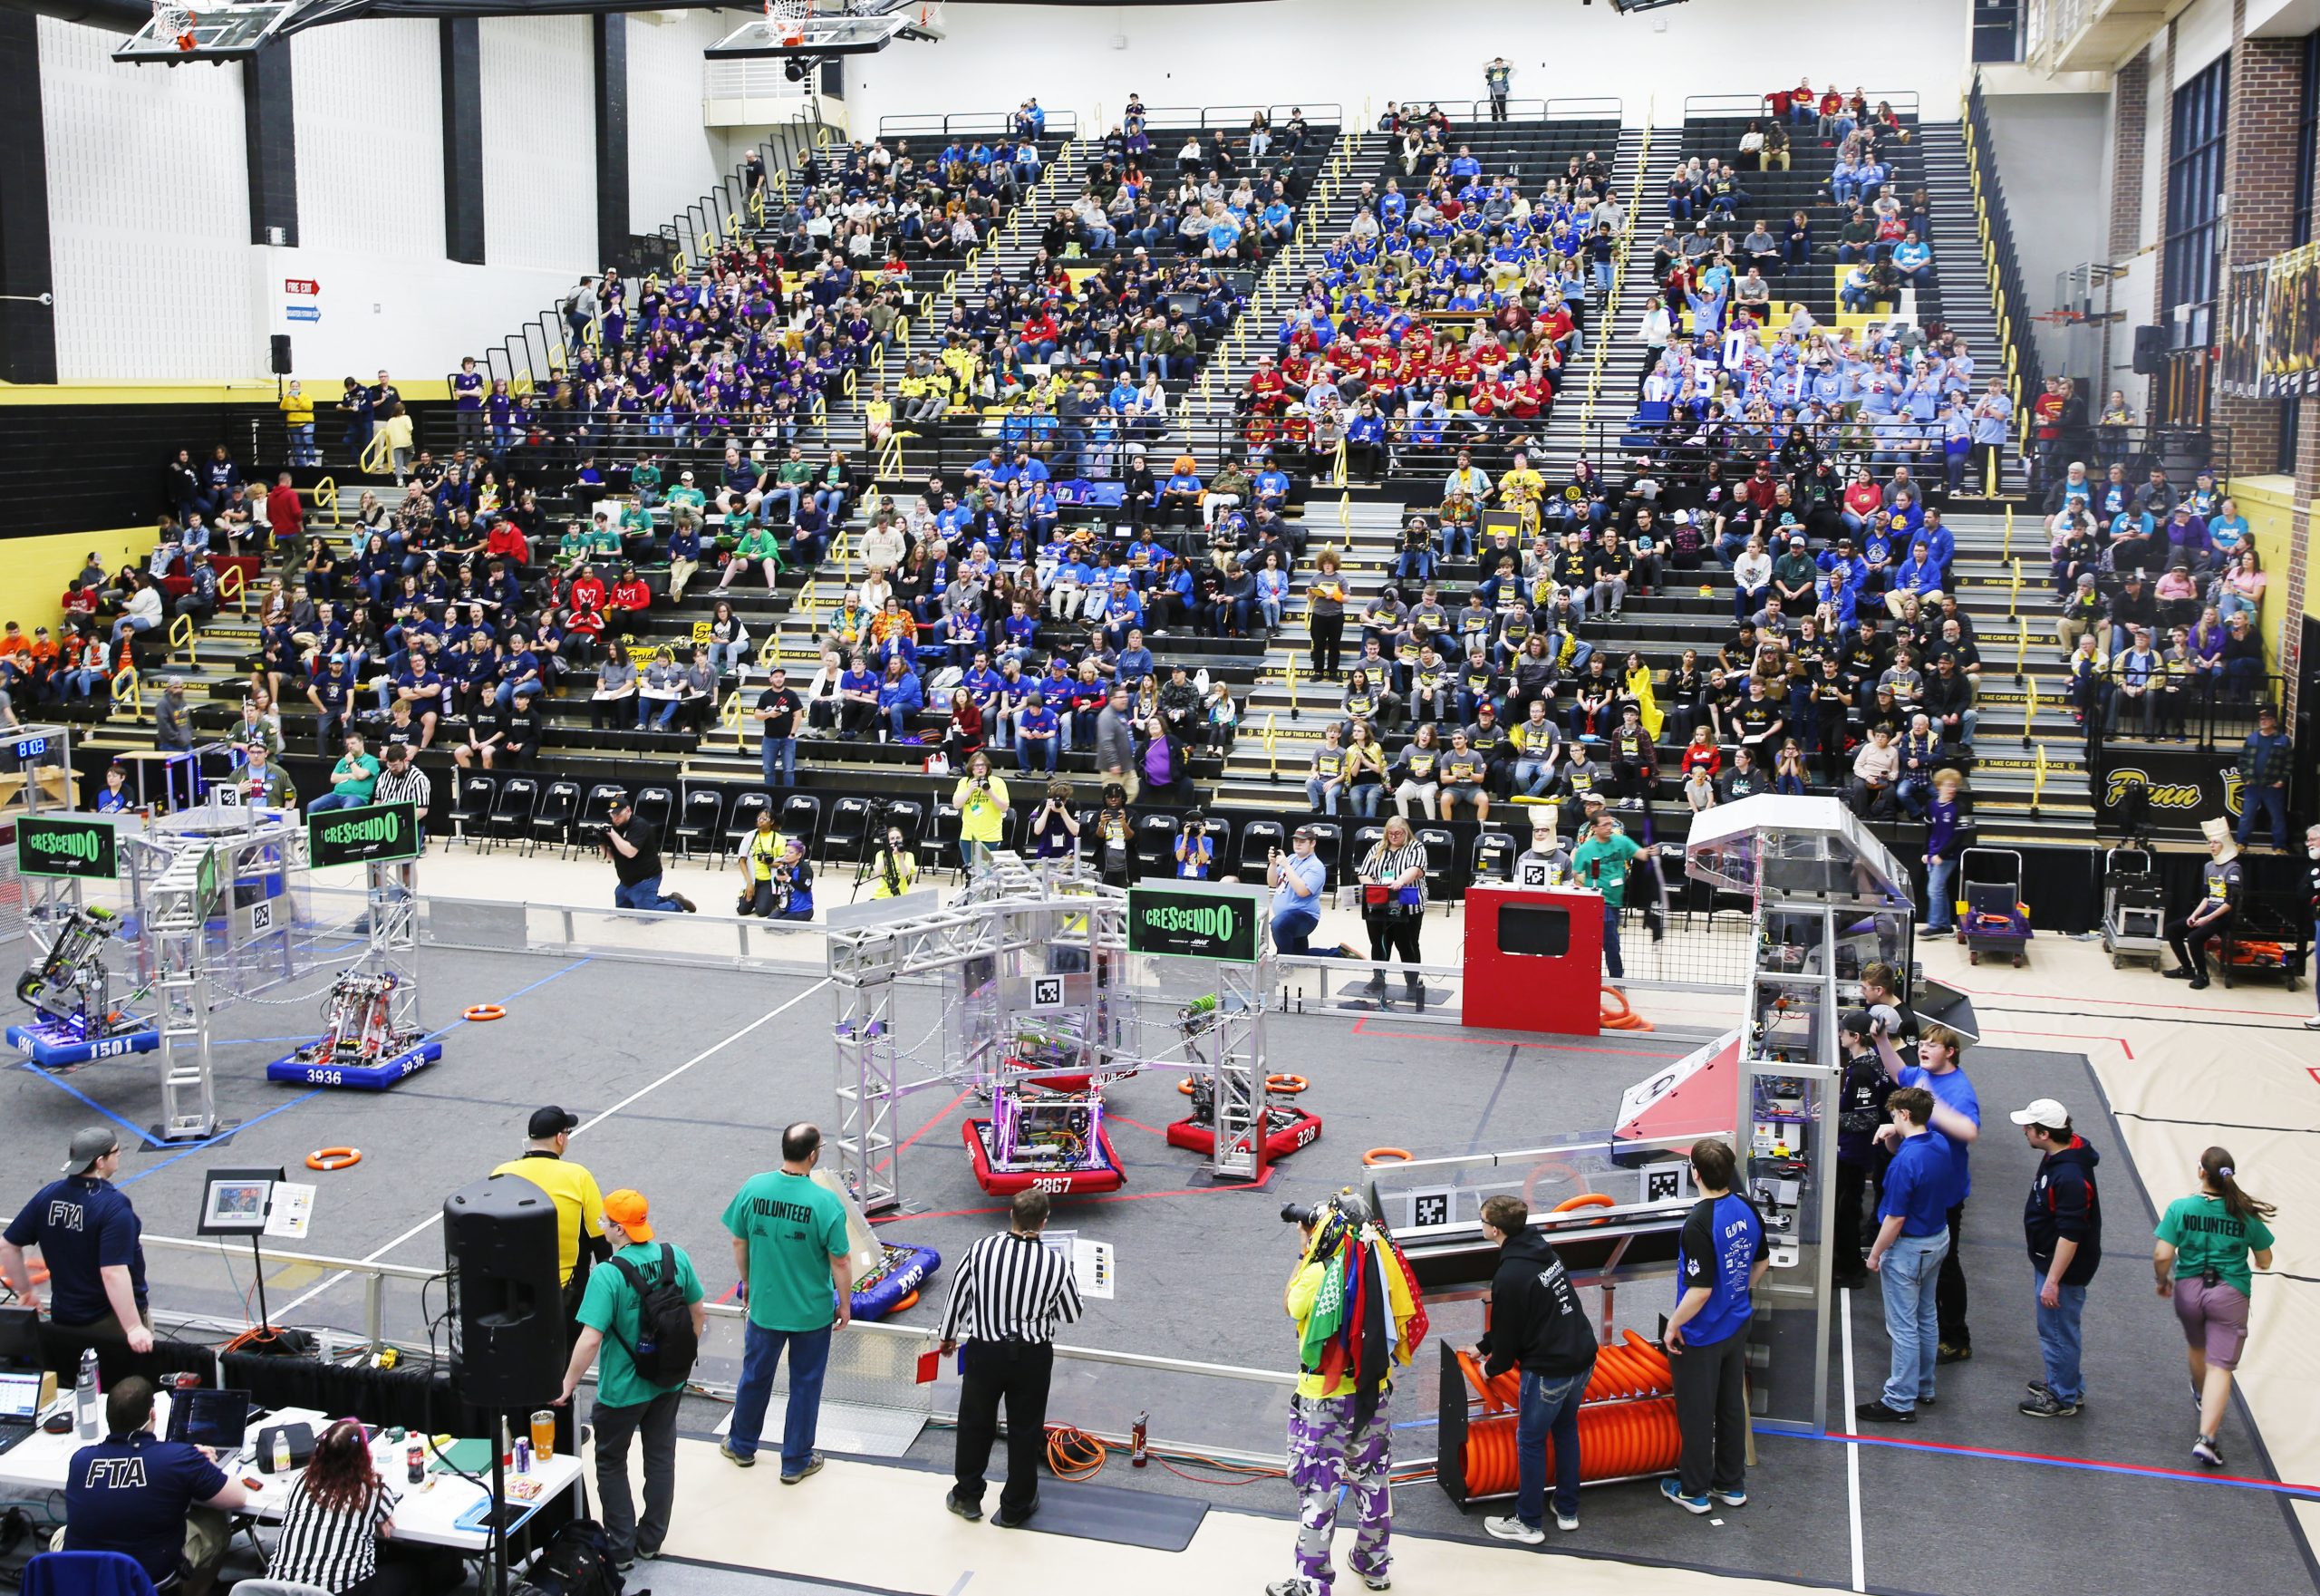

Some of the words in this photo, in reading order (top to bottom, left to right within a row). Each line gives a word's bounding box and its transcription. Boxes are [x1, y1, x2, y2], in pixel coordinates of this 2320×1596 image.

[1695, 360, 1717, 398] 5
[324, 811, 399, 844] CRESCENDO
[31, 829, 99, 863] CRESCENDO
[1146, 904, 1233, 942] CRESCENDO
[91, 1038, 132, 1059] 1501
[306, 1069, 342, 1085] 3936
[401, 1052, 425, 1077] 3936
[1297, 1126, 1317, 1147] 328
[1032, 1177, 1072, 1194] 2867
[48, 1200, 83, 1232] FTA
[752, 1197, 813, 1224] VOLUNTEER
[2183, 1214, 2247, 1239] VOLUNTEER
[85, 1456, 147, 1488] FTA
